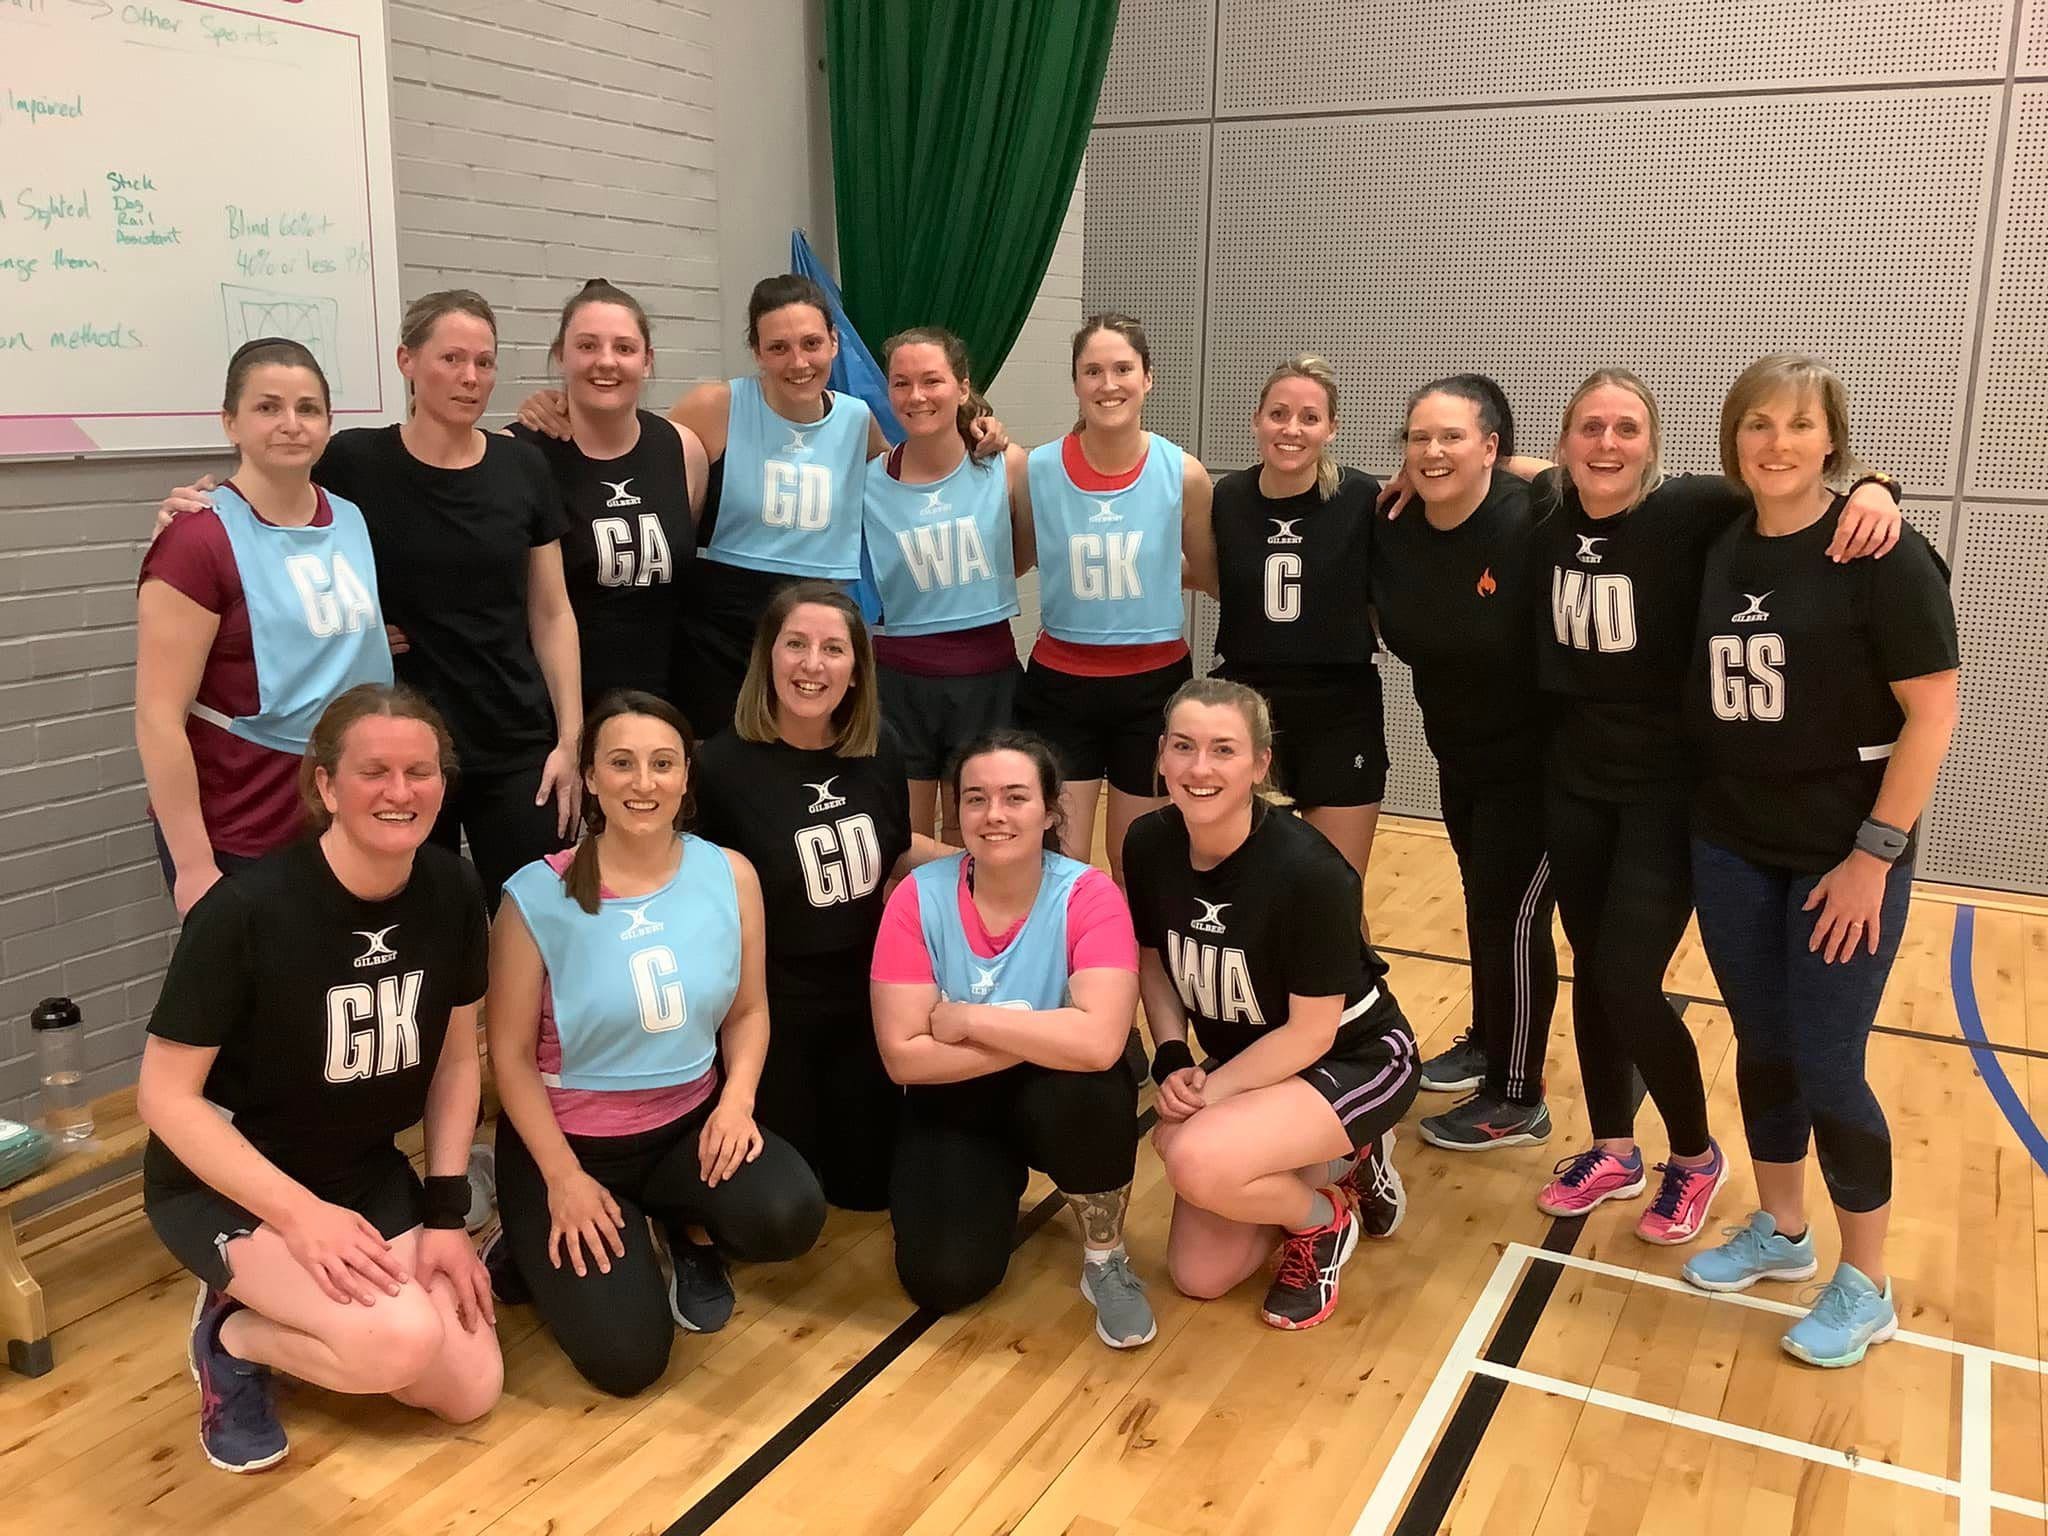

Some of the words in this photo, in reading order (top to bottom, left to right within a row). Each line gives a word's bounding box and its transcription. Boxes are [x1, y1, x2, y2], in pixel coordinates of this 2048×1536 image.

[121, 4, 183, 33] Other
[106, 171, 158, 192] Stick
[117, 211, 154, 226] Rail
[225, 204, 270, 240] Blind
[0, 256, 40, 282] nge
[761, 458, 834, 532] GD
[592, 512, 673, 588] GA
[896, 515, 994, 592] WA
[1068, 530, 1145, 601] GK
[1267, 536, 1304, 545] GILBERT
[284, 551, 377, 638] GA
[1264, 552, 1302, 623] C
[1551, 564, 1637, 653] WD
[1708, 632, 1786, 722] GS
[808, 796, 847, 814] GILBERT
[793, 812, 882, 908] GD
[629, 945, 687, 1033] C
[1168, 929, 1267, 1025] WA
[323, 969, 424, 1084] GK
